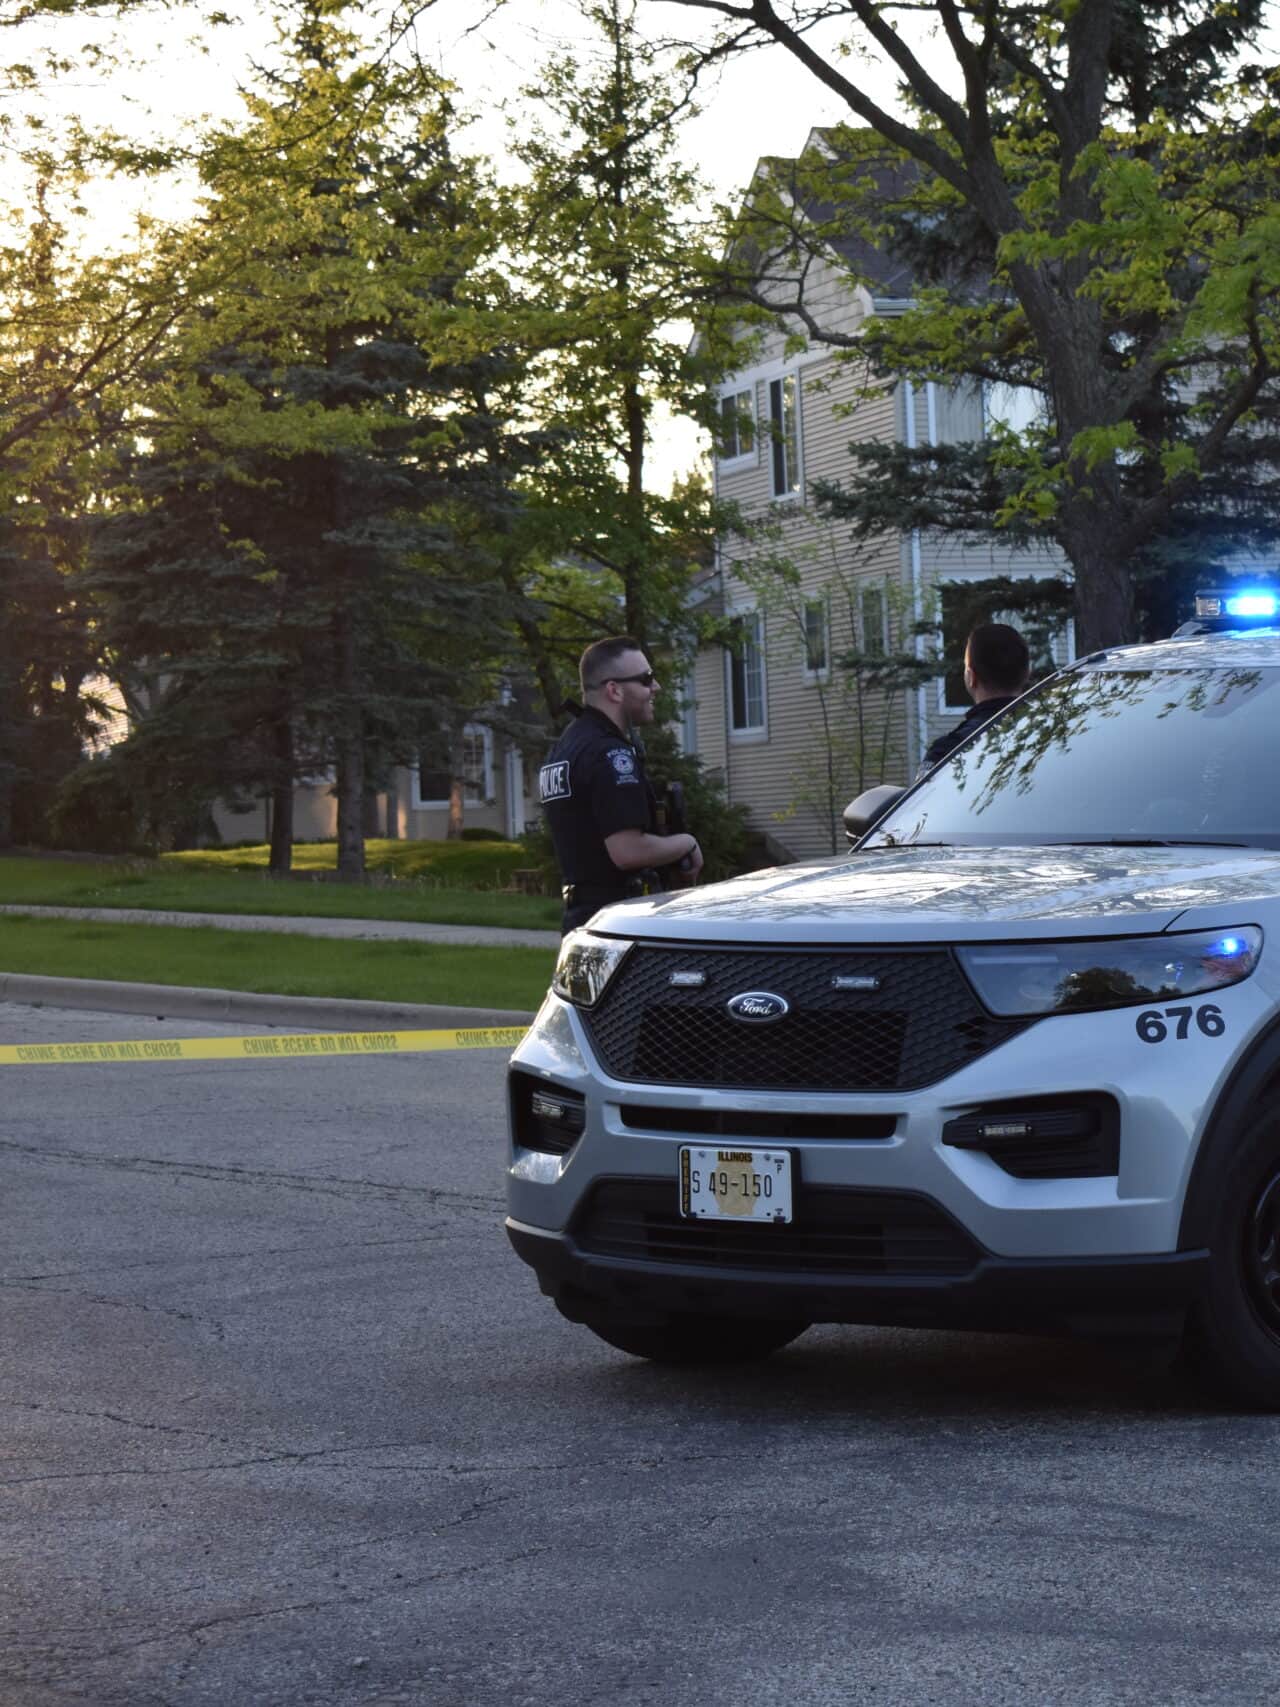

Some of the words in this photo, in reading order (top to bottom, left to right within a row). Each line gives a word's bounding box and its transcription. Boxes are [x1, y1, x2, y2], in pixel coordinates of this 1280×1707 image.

[740, 997, 773, 1015] Ford
[1135, 1003, 1226, 1044] 676
[718, 1151, 753, 1163] ILLINOIS
[692, 1170, 701, 1194] S
[708, 1171, 772, 1198] 49-150
